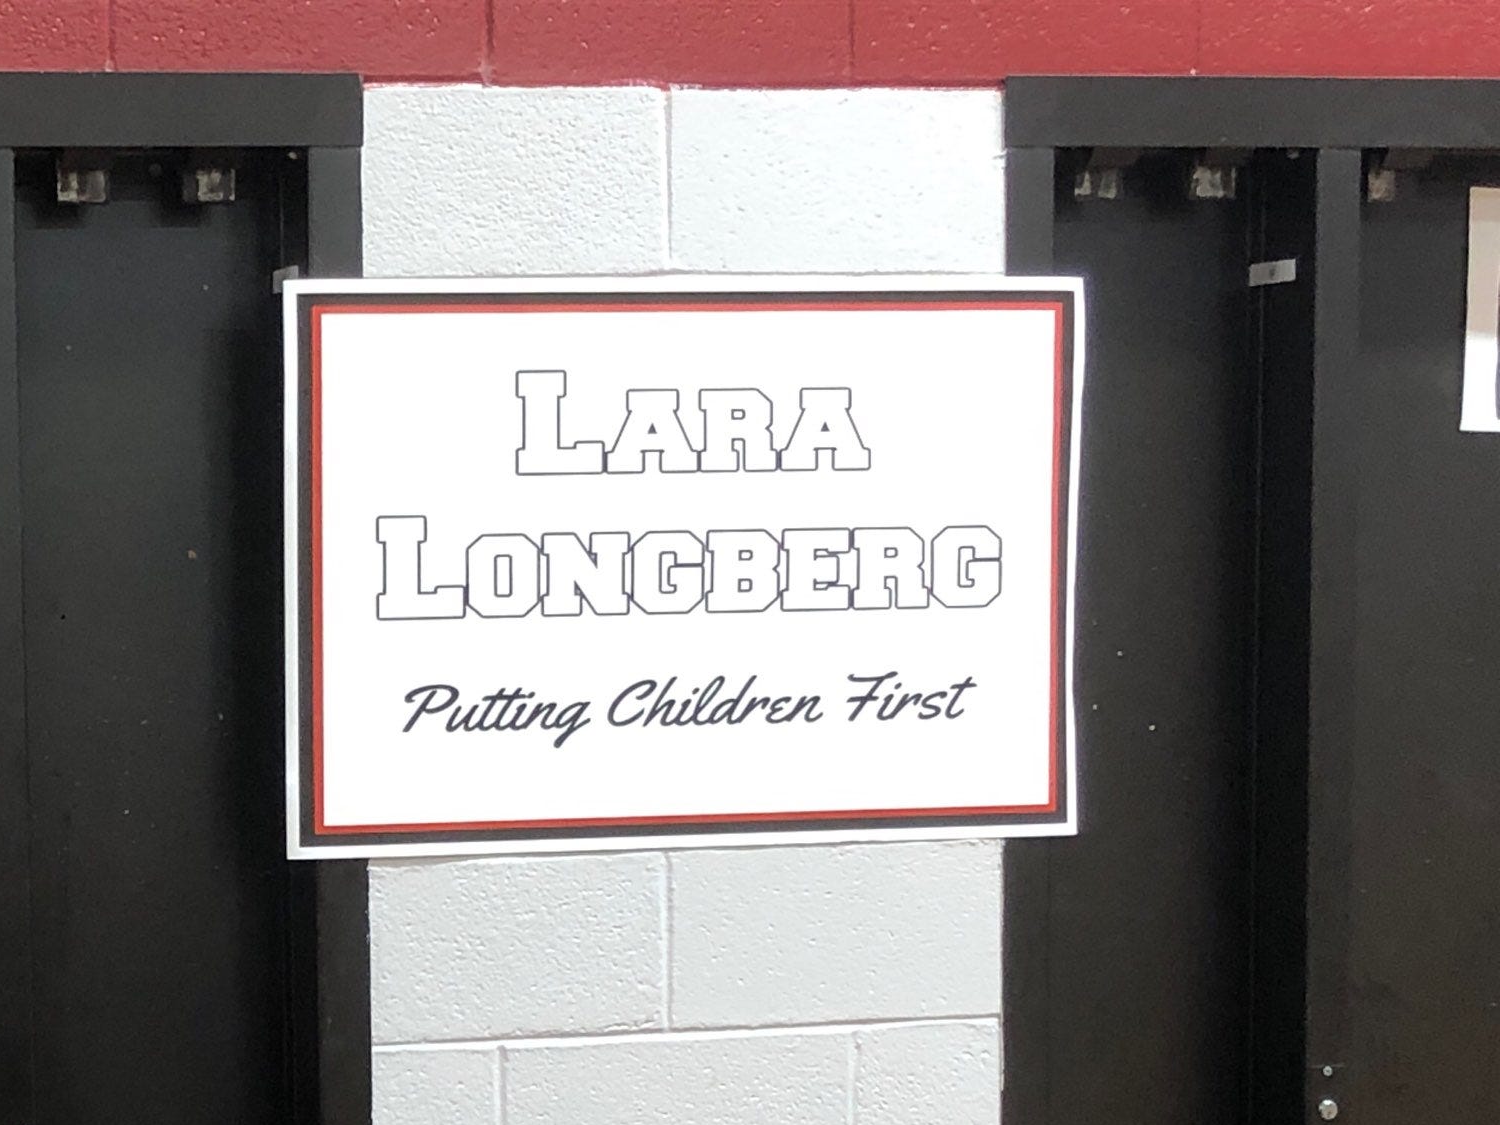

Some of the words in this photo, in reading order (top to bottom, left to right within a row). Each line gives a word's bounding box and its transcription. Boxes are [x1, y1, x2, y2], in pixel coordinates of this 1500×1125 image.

[515, 370, 871, 476] LARA
[376, 515, 1002, 621] LONGBERG
[403, 684, 591, 748] Putting
[607, 675, 823, 727] Children
[847, 671, 977, 721] First
